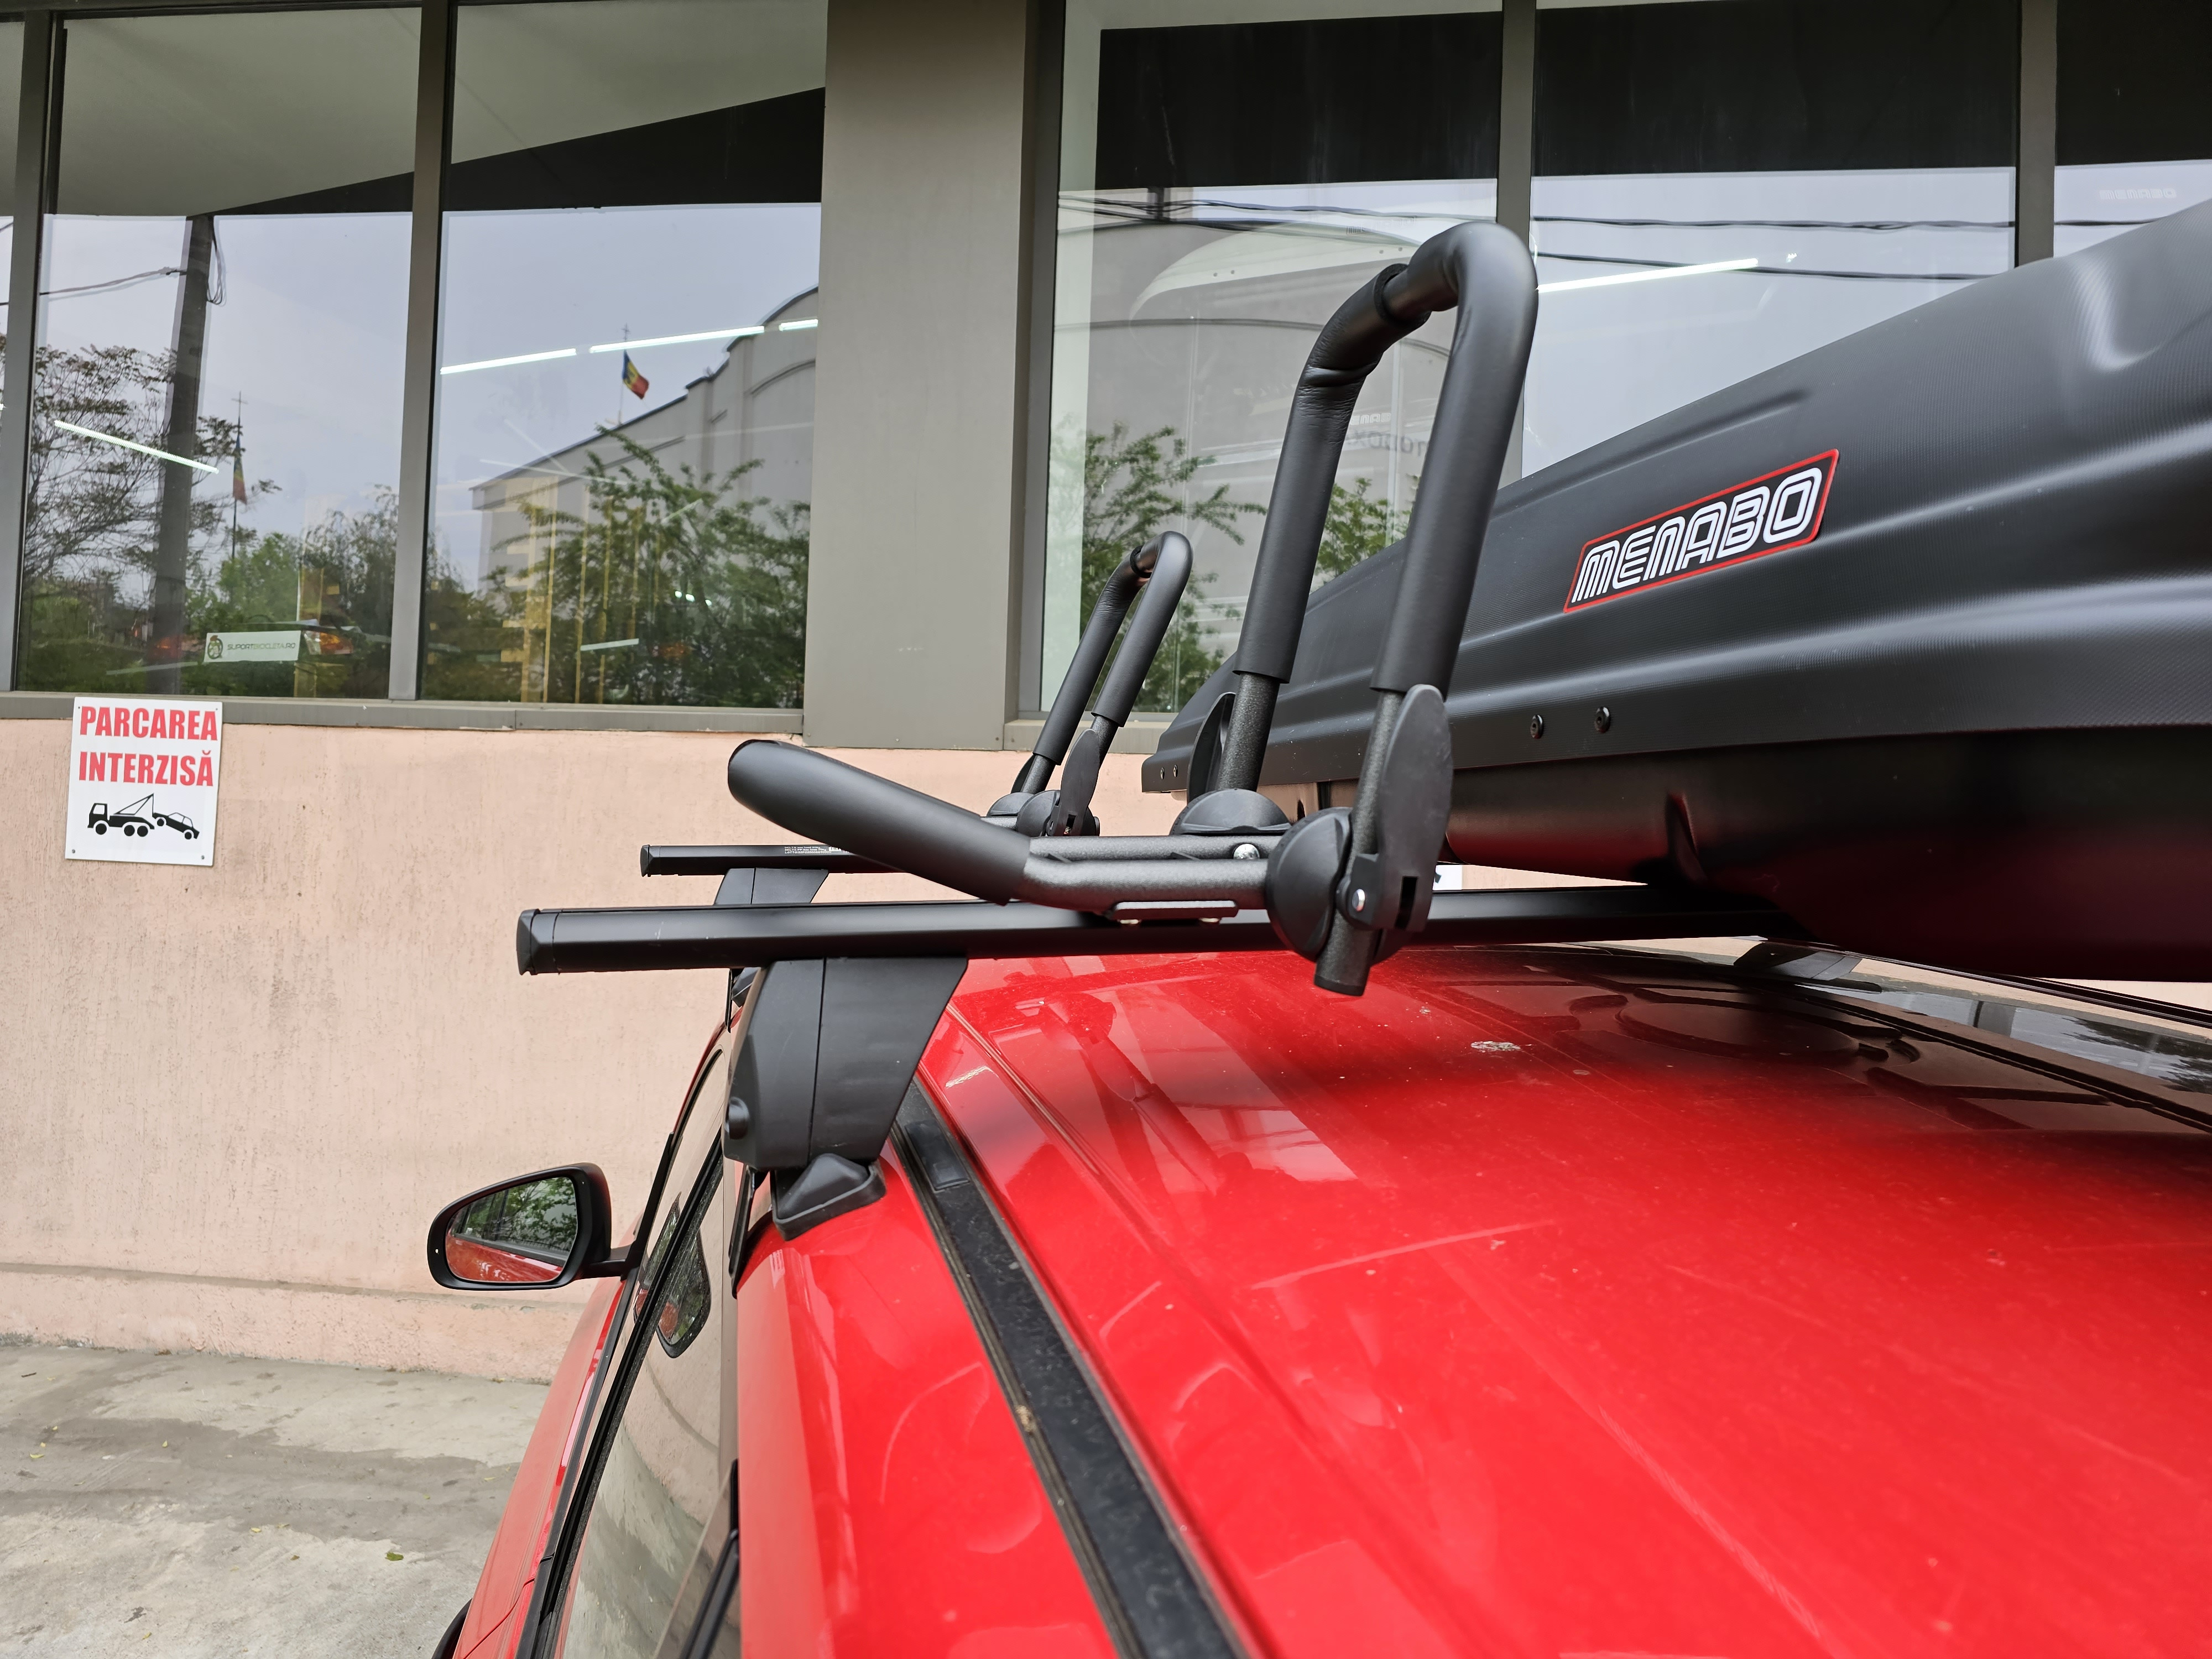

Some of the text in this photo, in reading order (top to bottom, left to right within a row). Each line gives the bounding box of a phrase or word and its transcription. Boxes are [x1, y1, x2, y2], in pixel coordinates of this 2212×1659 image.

[1350, 413, 1391, 425] ENAB
[1571, 467, 1822, 603] MENABO
[80, 706, 218, 740] PARCAREA
[79, 750, 213, 786] INTERZISĂ
